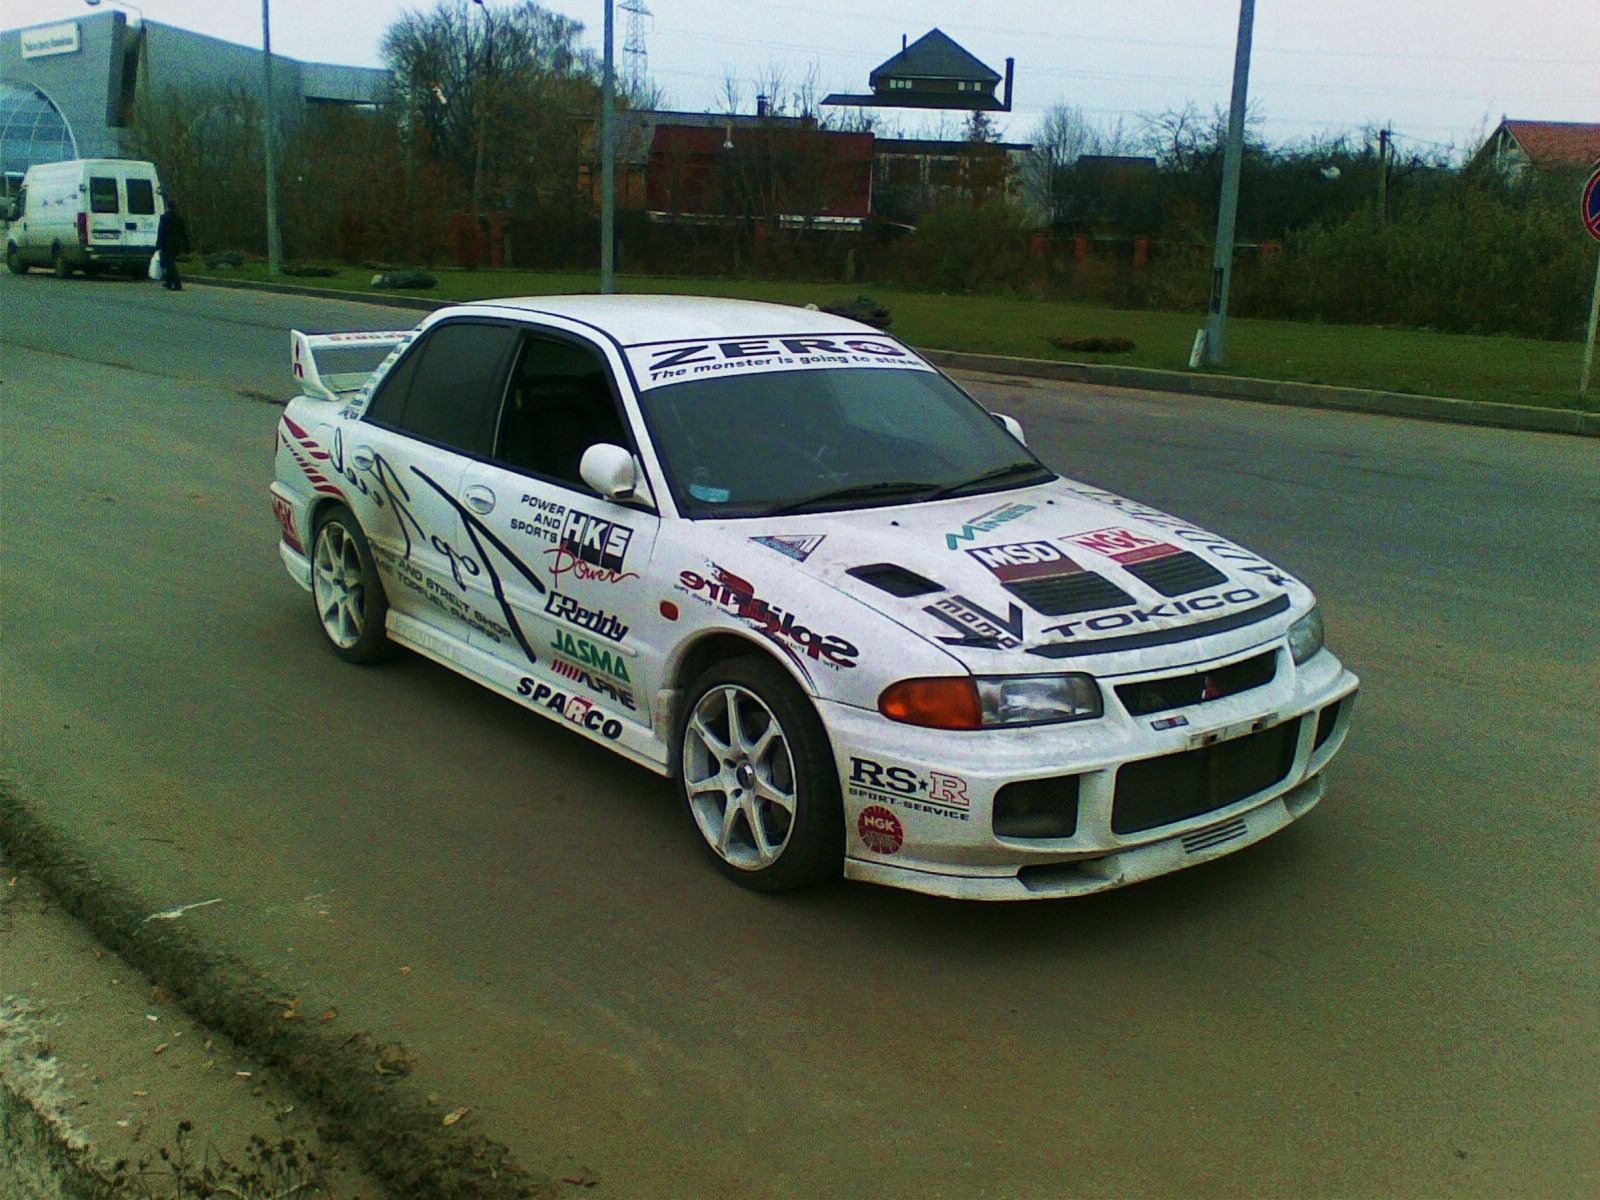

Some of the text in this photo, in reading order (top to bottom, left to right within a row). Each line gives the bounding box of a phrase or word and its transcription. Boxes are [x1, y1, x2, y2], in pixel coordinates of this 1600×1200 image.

[649, 339, 906, 370] ZERO
[650, 369, 687, 381] The
[693, 358, 771, 373] monster
[777, 355, 794, 364] is
[800, 354, 849, 364] going
[852, 355, 870, 363] to
[521, 494, 566, 517] POWER
[510, 519, 557, 543] SPORTS
[533, 512, 562, 529] AND
[561, 509, 632, 565] HKS
[1076, 528, 1156, 555] NGK
[544, 541, 640, 589] Power
[976, 543, 1061, 568] MSD
[1041, 588, 1260, 637] TOKICO
[550, 628, 631, 683] JASMA
[516, 676, 623, 740] SPARCO
[864, 815, 896, 833] NGK
